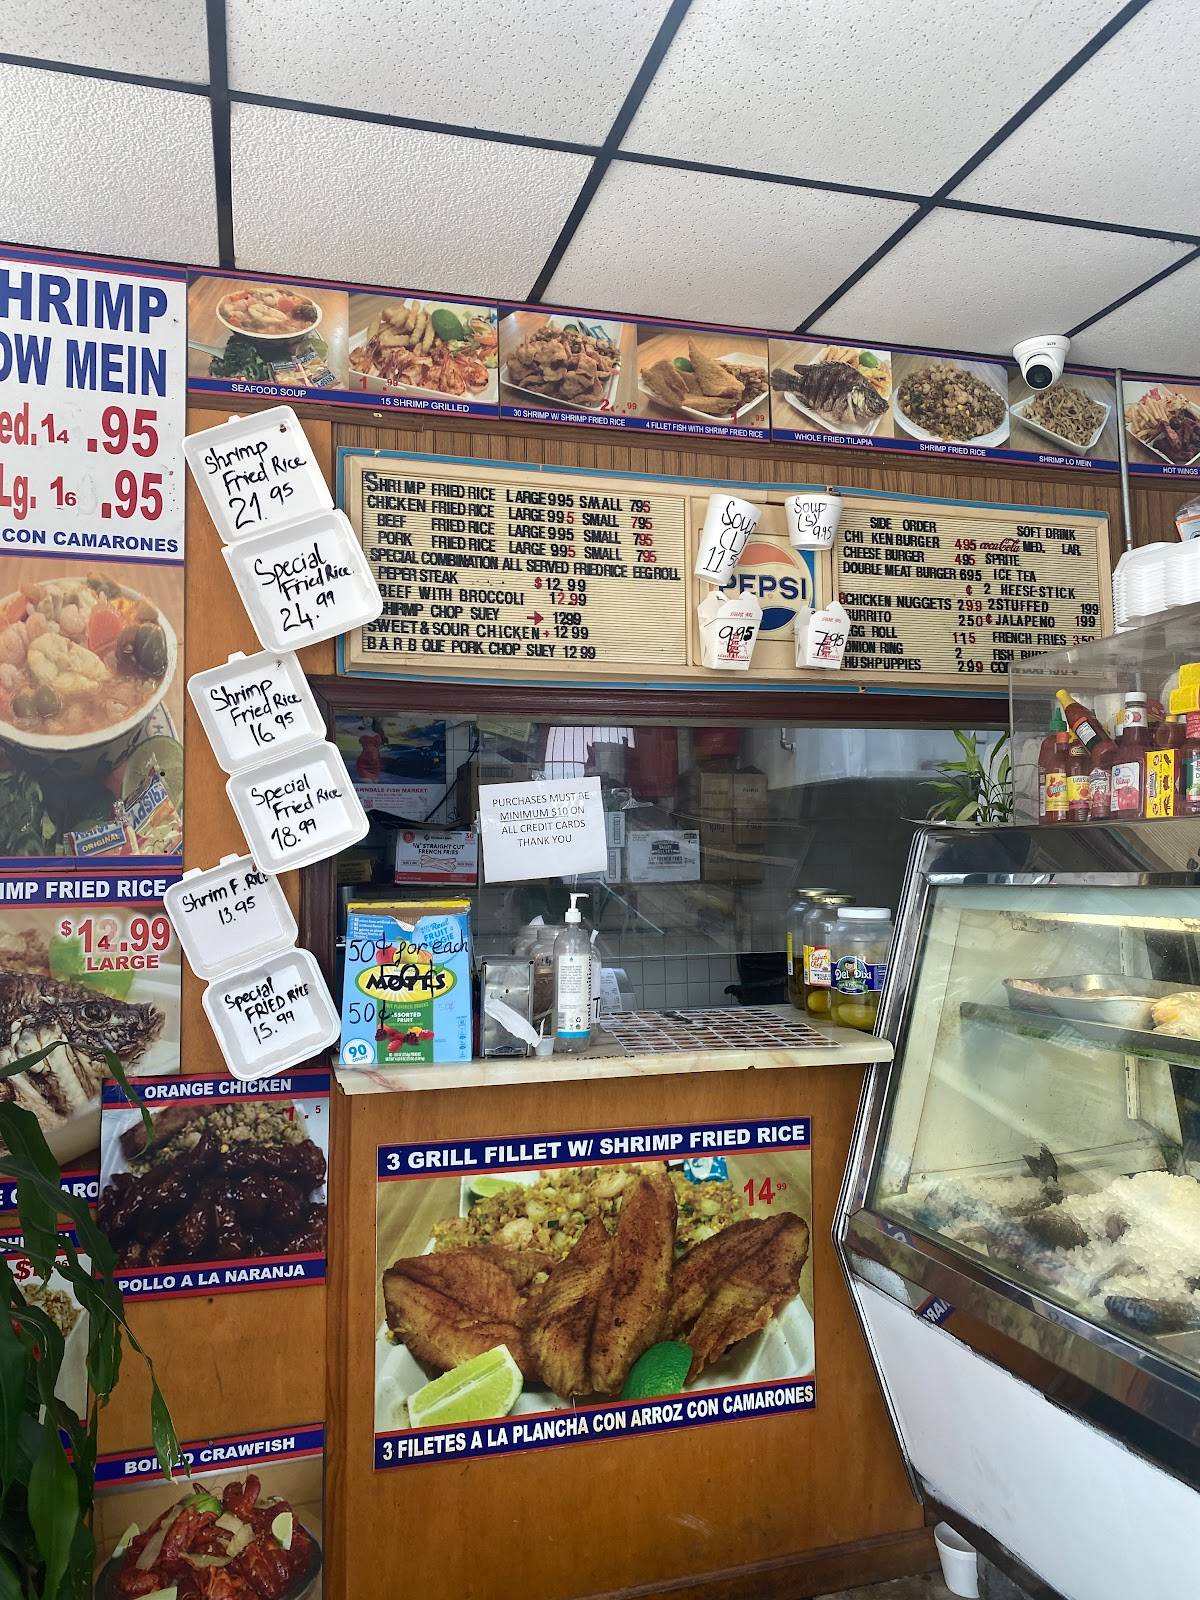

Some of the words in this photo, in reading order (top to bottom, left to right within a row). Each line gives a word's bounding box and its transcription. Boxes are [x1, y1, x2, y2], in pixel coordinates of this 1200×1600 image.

[66, 339, 166, 397] MEIN
[231, 383, 277, 395] SEAFOOD
[280, 387, 306, 398] SOUP
[380, 397, 391, 406] 15
[392, 398, 429, 409] SHRIMP
[431, 401, 470, 413] GRILLED
[513, 409, 521, 417] 30
[522, 409, 549, 419] SHRIMP
[560, 413, 588, 423] SHRIMP
[588, 415, 609, 425] FRIED
[609, 418, 626, 427] RICE
[651, 422, 672, 431] FILLET
[672, 424, 687, 432] FISH
[688, 425, 704, 433] WITH
[705, 426, 729, 435] SHRIMP
[729, 428, 748, 437] FRIED
[748, 430, 763, 439] RICE
[794, 432, 822, 442] WHOLE
[823, 435, 845, 444] FRIED
[846, 436, 873, 446] TILAPIA
[205, 441, 268, 474] Shrimp
[919, 443, 947, 453] SHRIMP
[948, 446, 969, 455] FRIED
[969, 448, 986, 457] RICE
[1039, 455, 1065, 465] SHRIMP
[1066, 458, 1075, 466] LO
[1076, 459, 1092, 468] MEIN
[1163, 466, 1176, 475] HOT
[1177, 467, 1199, 476] WINGS
[222, 462, 269, 496] Fried
[271, 456, 307, 476] Rice
[431, 482, 464, 499] FRIED
[468, 485, 496, 501] RICE
[506, 489, 546, 506] LARGE
[548, 492, 574, 507] 995
[580, 495, 623, 512] SMALL
[366, 495, 426, 512] CHICKEN
[431, 500, 465, 516] FRIED
[468, 503, 495, 518] RICE
[508, 506, 546, 523] LARGE
[547, 509, 575, 525] 995
[582, 512, 619, 528] SMALL
[794, 496, 828, 520] Soup
[377, 513, 406, 528] BEEF
[431, 517, 465, 533] FRIED
[468, 520, 495, 535] RICE
[508, 523, 546, 540] LARGE
[547, 526, 574, 541] 995
[583, 529, 621, 545] SMALL
[870, 517, 892, 530] SIDE
[902, 519, 937, 533] ORDER
[1016, 525, 1042, 539] SOFT
[1045, 527, 1076, 541] DRINK
[2, 528, 46, 544] CON
[53, 531, 178, 552] CAMARONES
[377, 530, 413, 547] PORK
[431, 535, 466, 551] FRIED
[468, 538, 496, 553] RICE
[508, 540, 546, 556] LARGE
[584, 546, 622, 562] SMALL
[895, 533, 940, 549] BURGER
[954, 538, 977, 551] 495
[370, 547, 419, 565] SPECIAL
[421, 551, 499, 570] COMBINATION
[503, 557, 523, 572] ALL
[526, 558, 569, 575] SERVED
[843, 545, 881, 560] CHEESE
[885, 548, 924, 563] BURGER
[954, 553, 976, 566] 495
[985, 553, 1021, 567] SPRITE
[254, 542, 326, 593] Special
[378, 565, 417, 582] PEPER
[419, 568, 459, 585] STEAK
[843, 560, 882, 576] DOUBLE
[884, 563, 912, 578] MEAT
[916, 566, 957, 581] BURGER
[993, 568, 1012, 581] ICE
[1016, 570, 1037, 583] TEA
[280, 567, 324, 601] Fried
[378, 584, 412, 600] BEEF
[419, 585, 452, 602] WITH
[459, 588, 524, 606] BROCCOLI
[896, 597, 952, 611] NUGGETS
[431, 604, 463, 620] CHOP
[470, 606, 500, 621] SUEY
[844, 609, 892, 623] BURRITO
[995, 615, 1056, 629] JALAPENO
[367, 618, 418, 635] SWEET
[432, 622, 470, 638] SOUR
[476, 624, 540, 642] CHICKEN
[872, 625, 898, 639] ROLL
[992, 631, 1032, 645] FRENCH
[1037, 633, 1066, 646] FRIES
[451, 640, 484, 655] PORK
[488, 642, 521, 657] CHOP
[526, 643, 555, 658] SUEY
[880, 642, 904, 655] RING
[210, 679, 273, 711] Shrimp
[230, 702, 273, 727] Fried
[251, 773, 310, 810] Special
[492, 794, 547, 808] PURCHASES
[550, 792, 576, 804] MUST
[578, 791, 590, 800] BE
[272, 793, 315, 821] Fried
[317, 788, 343, 805] Rice
[500, 809, 549, 821] MINIMUM
[551, 806, 568, 818] $10
[570, 805, 585, 815] ON
[501, 825, 518, 835] ALL
[520, 822, 552, 834] CREDIT
[555, 819, 586, 830] CARDS
[82, 833, 120, 852] ORIGINAL
[517, 837, 550, 848] THANK
[551, 834, 573, 845] YOU
[45, 880, 110, 899] FRIED
[117, 879, 167, 897] RICE
[182, 884, 228, 913] Shrim
[432, 928, 469, 954] each
[87, 954, 159, 971] LARGE
[834, 968, 849, 981] Del
[224, 976, 275, 1012] Special
[348, 1044, 367, 1058] 90
[144, 1081, 214, 1099] ORANGE
[218, 1078, 292, 1095] CHICKEN
[387, 1152, 401, 1172] 3
[407, 1147, 477, 1169] GRILL
[485, 1140, 562, 1164] FILLET
[567, 1138, 595, 1158] W/
[600, 1132, 683, 1156] SHRIMP
[690, 1127, 751, 1149] FRIED
[757, 1123, 805, 1145] RICE
[118, 1275, 176, 1293] POLLO
[181, 1274, 193, 1288] A
[198, 1271, 220, 1287] LA
[224, 1263, 305, 1284] NARANJA
[382, 1441, 394, 1461] 3
[397, 1431, 467, 1460] FILETES
[470, 1428, 483, 1451] A
[487, 1424, 509, 1447] LA
[513, 1413, 589, 1444] PLANCHA
[592, 1410, 628, 1432] CON
[630, 1401, 683, 1429] ARROZ
[686, 1396, 719, 1419] CON
[722, 1385, 815, 1417] CAMARONES
[200, 1437, 296, 1463] CRAWFISH
